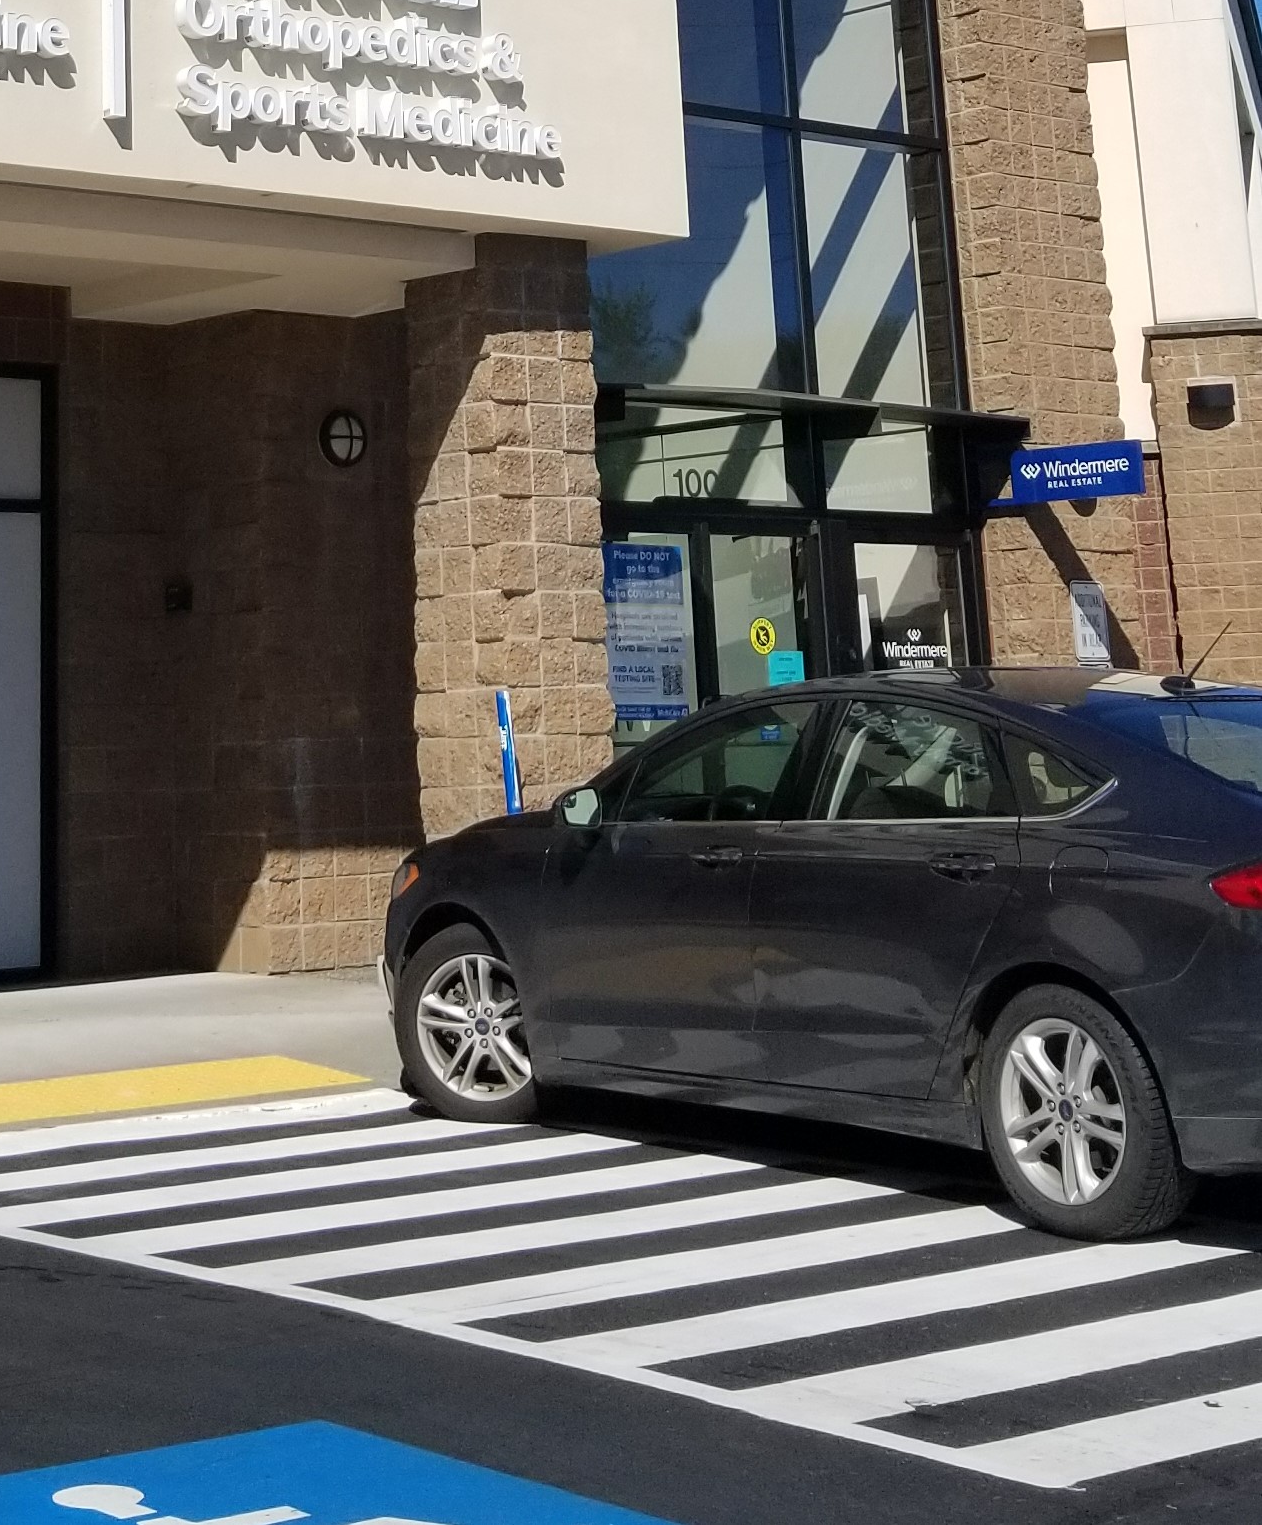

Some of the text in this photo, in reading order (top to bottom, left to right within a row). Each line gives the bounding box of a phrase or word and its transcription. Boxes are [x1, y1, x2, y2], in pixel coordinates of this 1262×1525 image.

[481, 32, 524, 83] &
[176, 64, 562, 160] Sports Medicine
[1043, 457, 1130, 478] Windermere
[672, 468, 720, 498] 100
[1047, 476, 1103, 489] REAL ESTATE
[640, 551, 652, 561] DO
[653, 552, 670, 561] NOT
[626, 565, 637, 575] go
[638, 564, 646, 573] to
[882, 641, 948, 658] Windermere
[613, 665, 628, 673] FIND
[614, 674, 641, 683] TESTING
